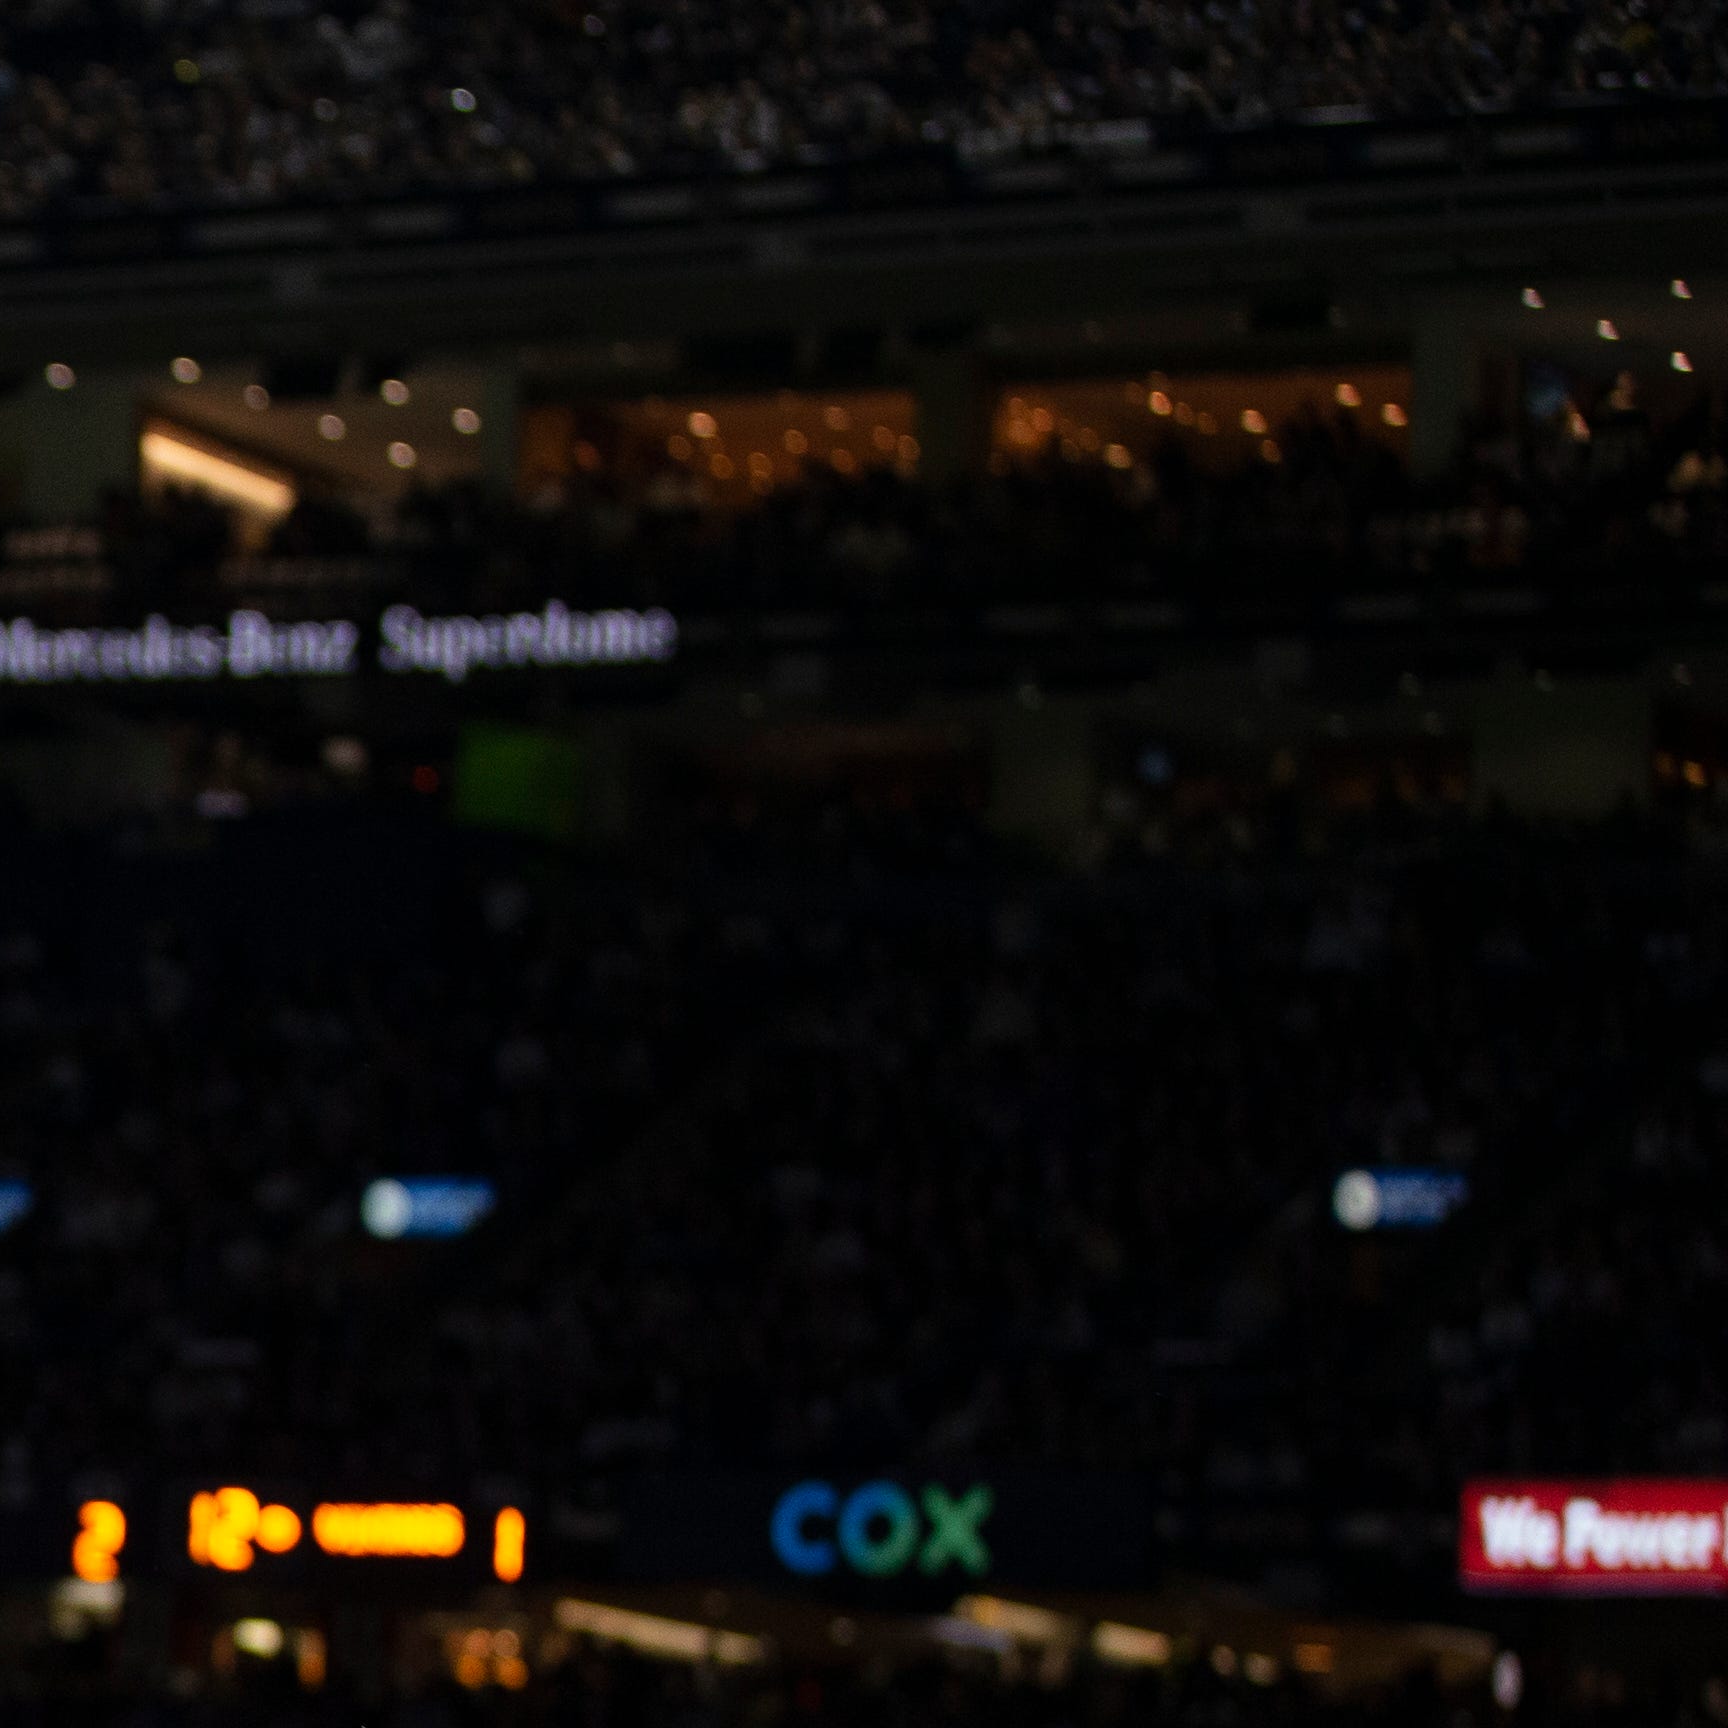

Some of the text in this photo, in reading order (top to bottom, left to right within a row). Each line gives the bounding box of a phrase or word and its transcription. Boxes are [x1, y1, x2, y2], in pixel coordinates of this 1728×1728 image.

[770, 1480, 994, 1577] COX
[1481, 1496, 1559, 1569] We
[1563, 1496, 1717, 1570] Power
